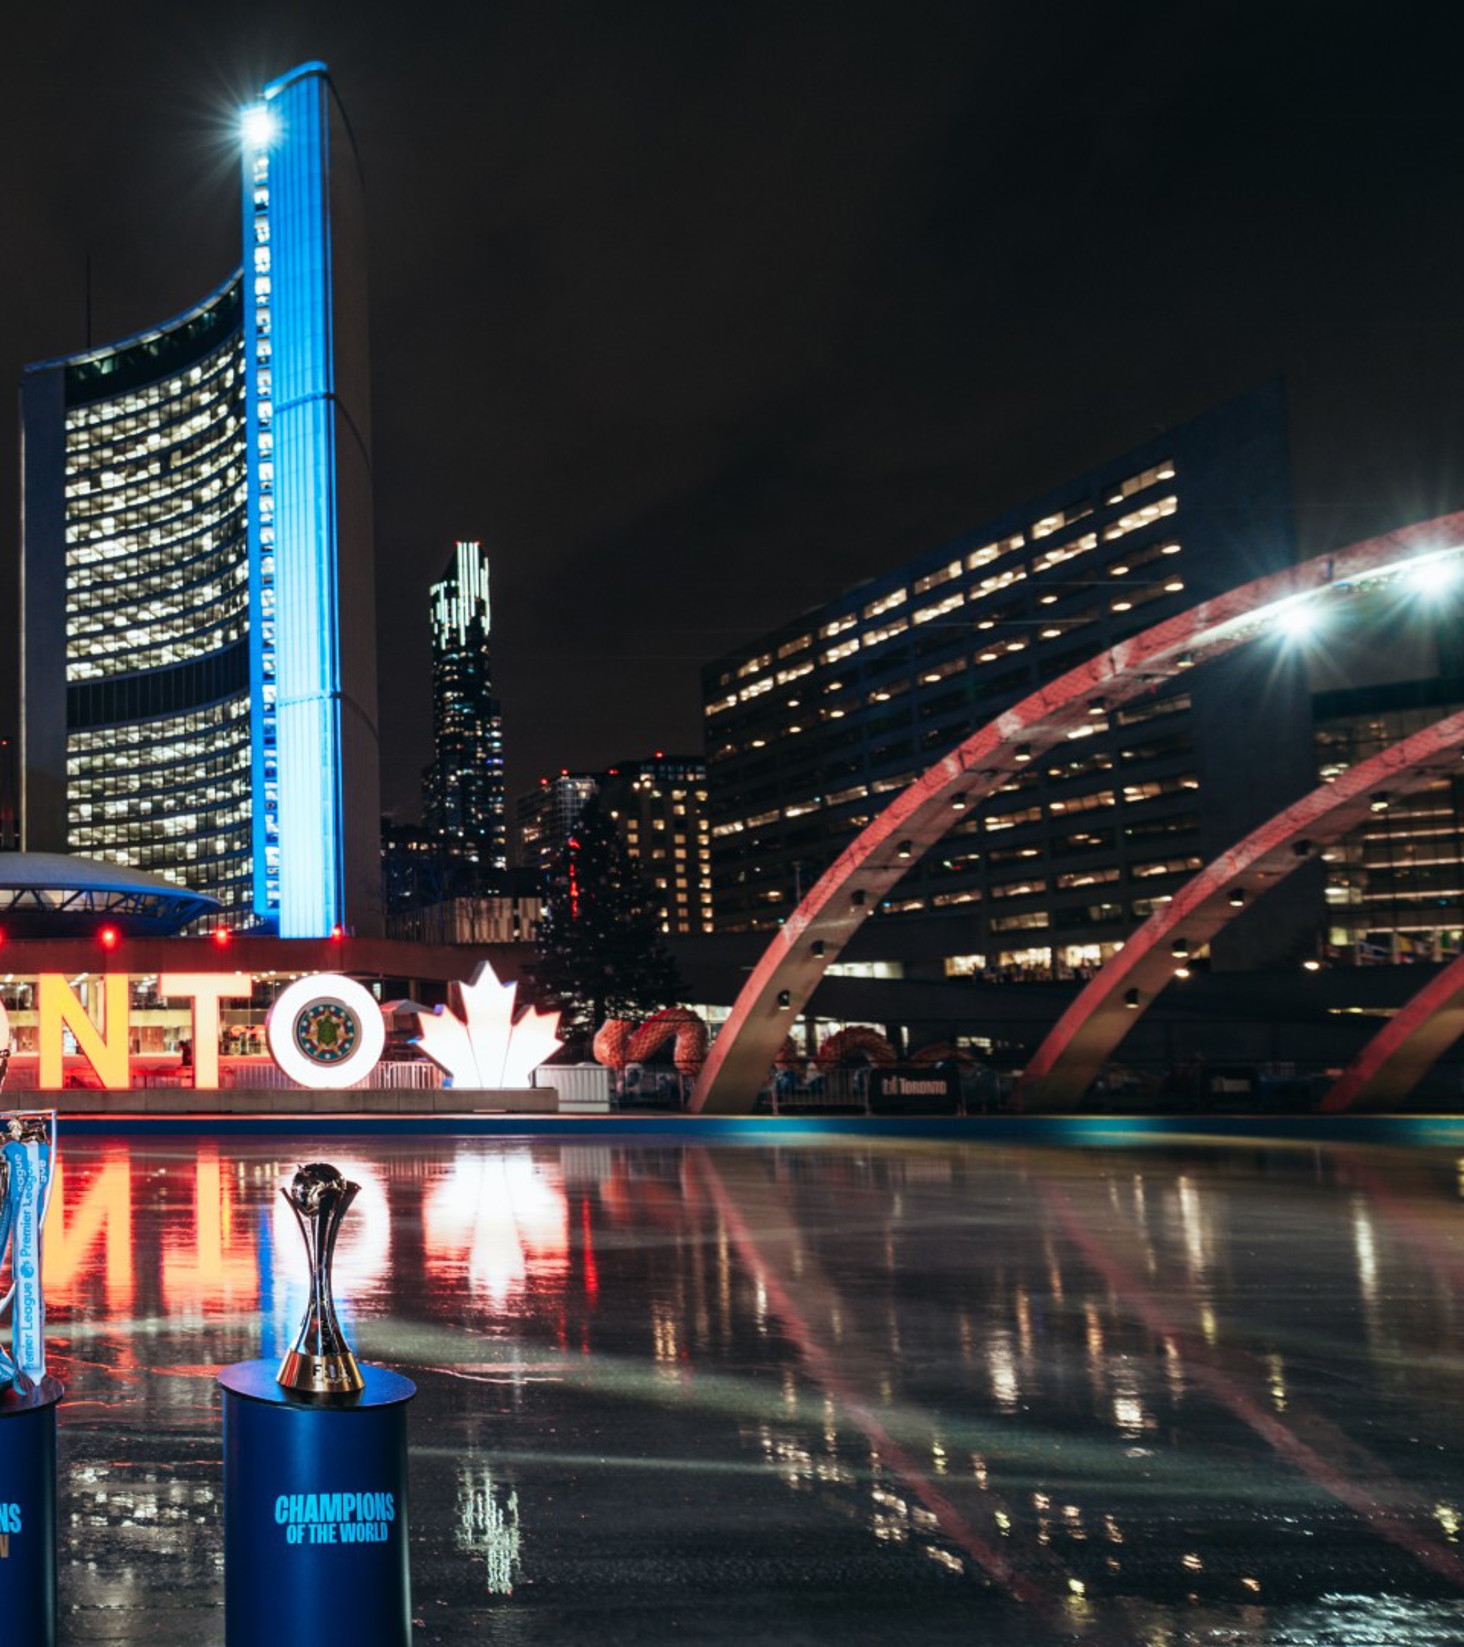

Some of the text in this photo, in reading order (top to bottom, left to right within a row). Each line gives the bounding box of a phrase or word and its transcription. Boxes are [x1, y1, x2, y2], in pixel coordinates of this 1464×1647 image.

[15, 1153, 27, 1194] eague
[20, 1211, 32, 1258] Premier
[21, 1282, 36, 1331] League
[275, 1492, 395, 1524] CHAMPIONS
[286, 1522, 389, 1544] OF THE WORLD
